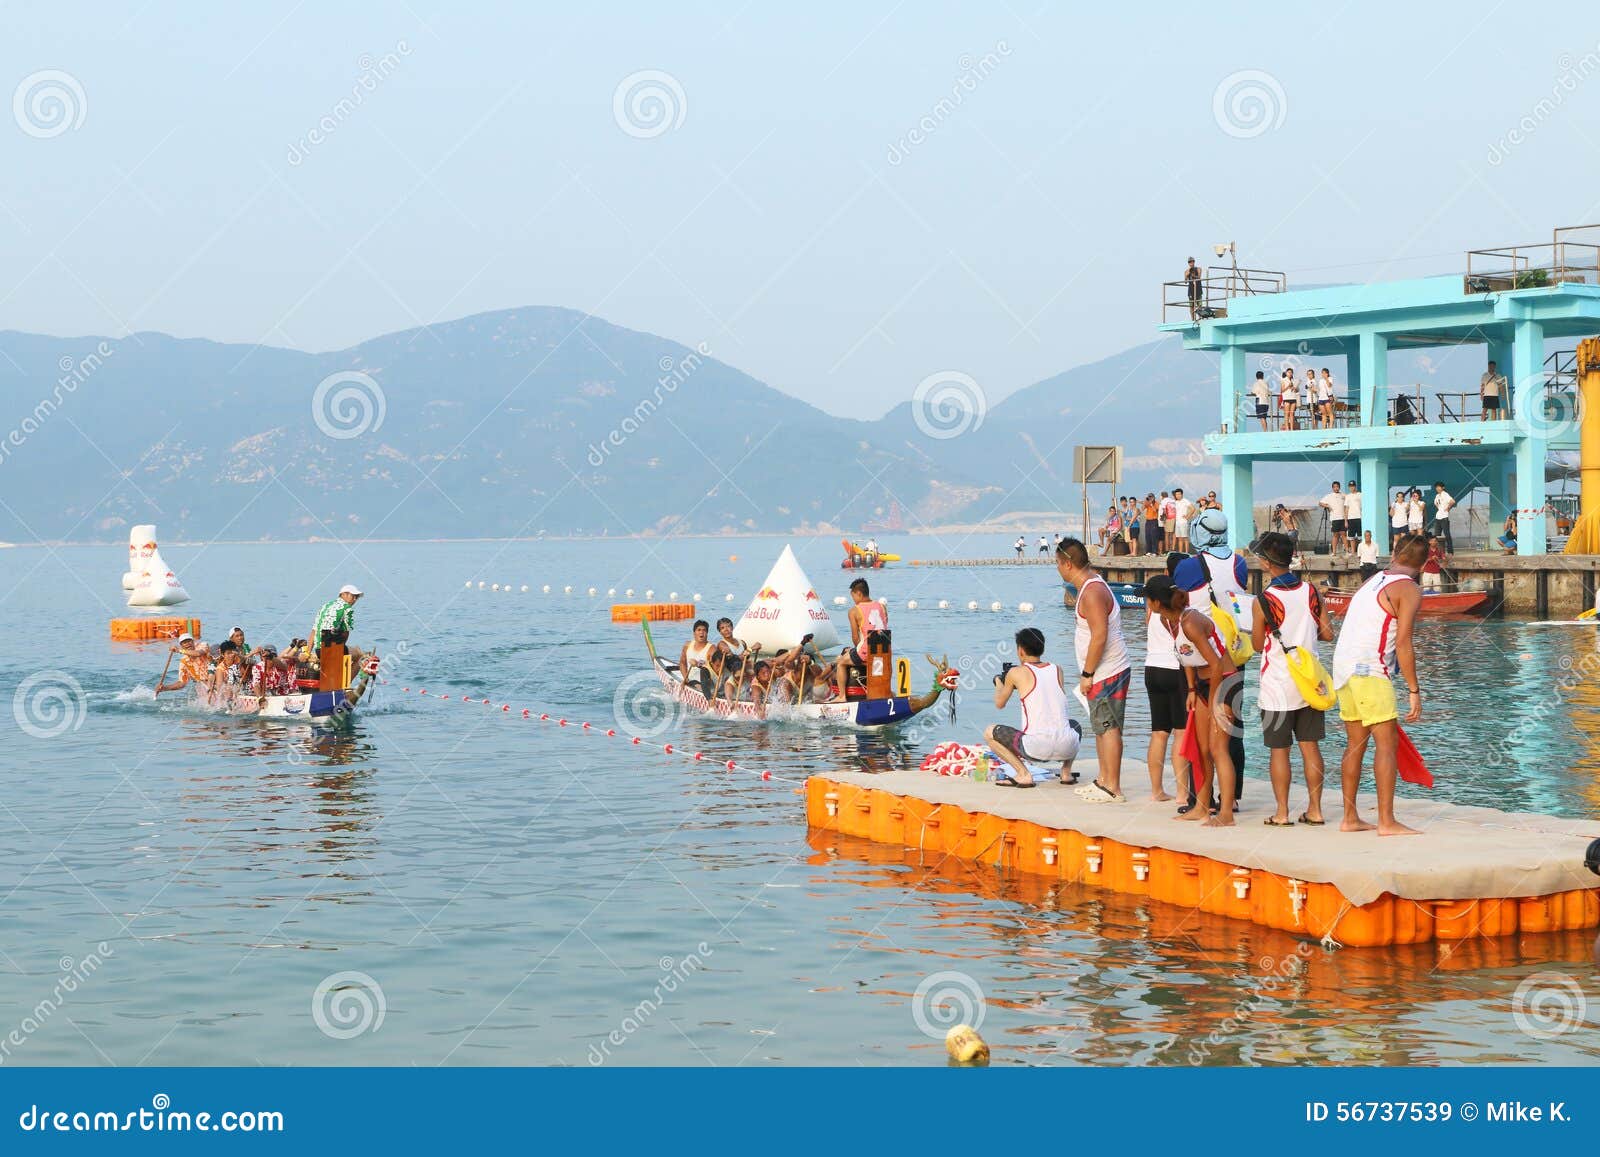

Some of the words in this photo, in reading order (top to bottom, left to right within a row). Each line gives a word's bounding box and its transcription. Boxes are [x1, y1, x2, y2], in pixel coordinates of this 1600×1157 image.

[760, 607, 781, 620] Bull
[873, 659, 883, 676] 2
[899, 660, 907, 694] 2
[887, 698, 896, 716] 2
